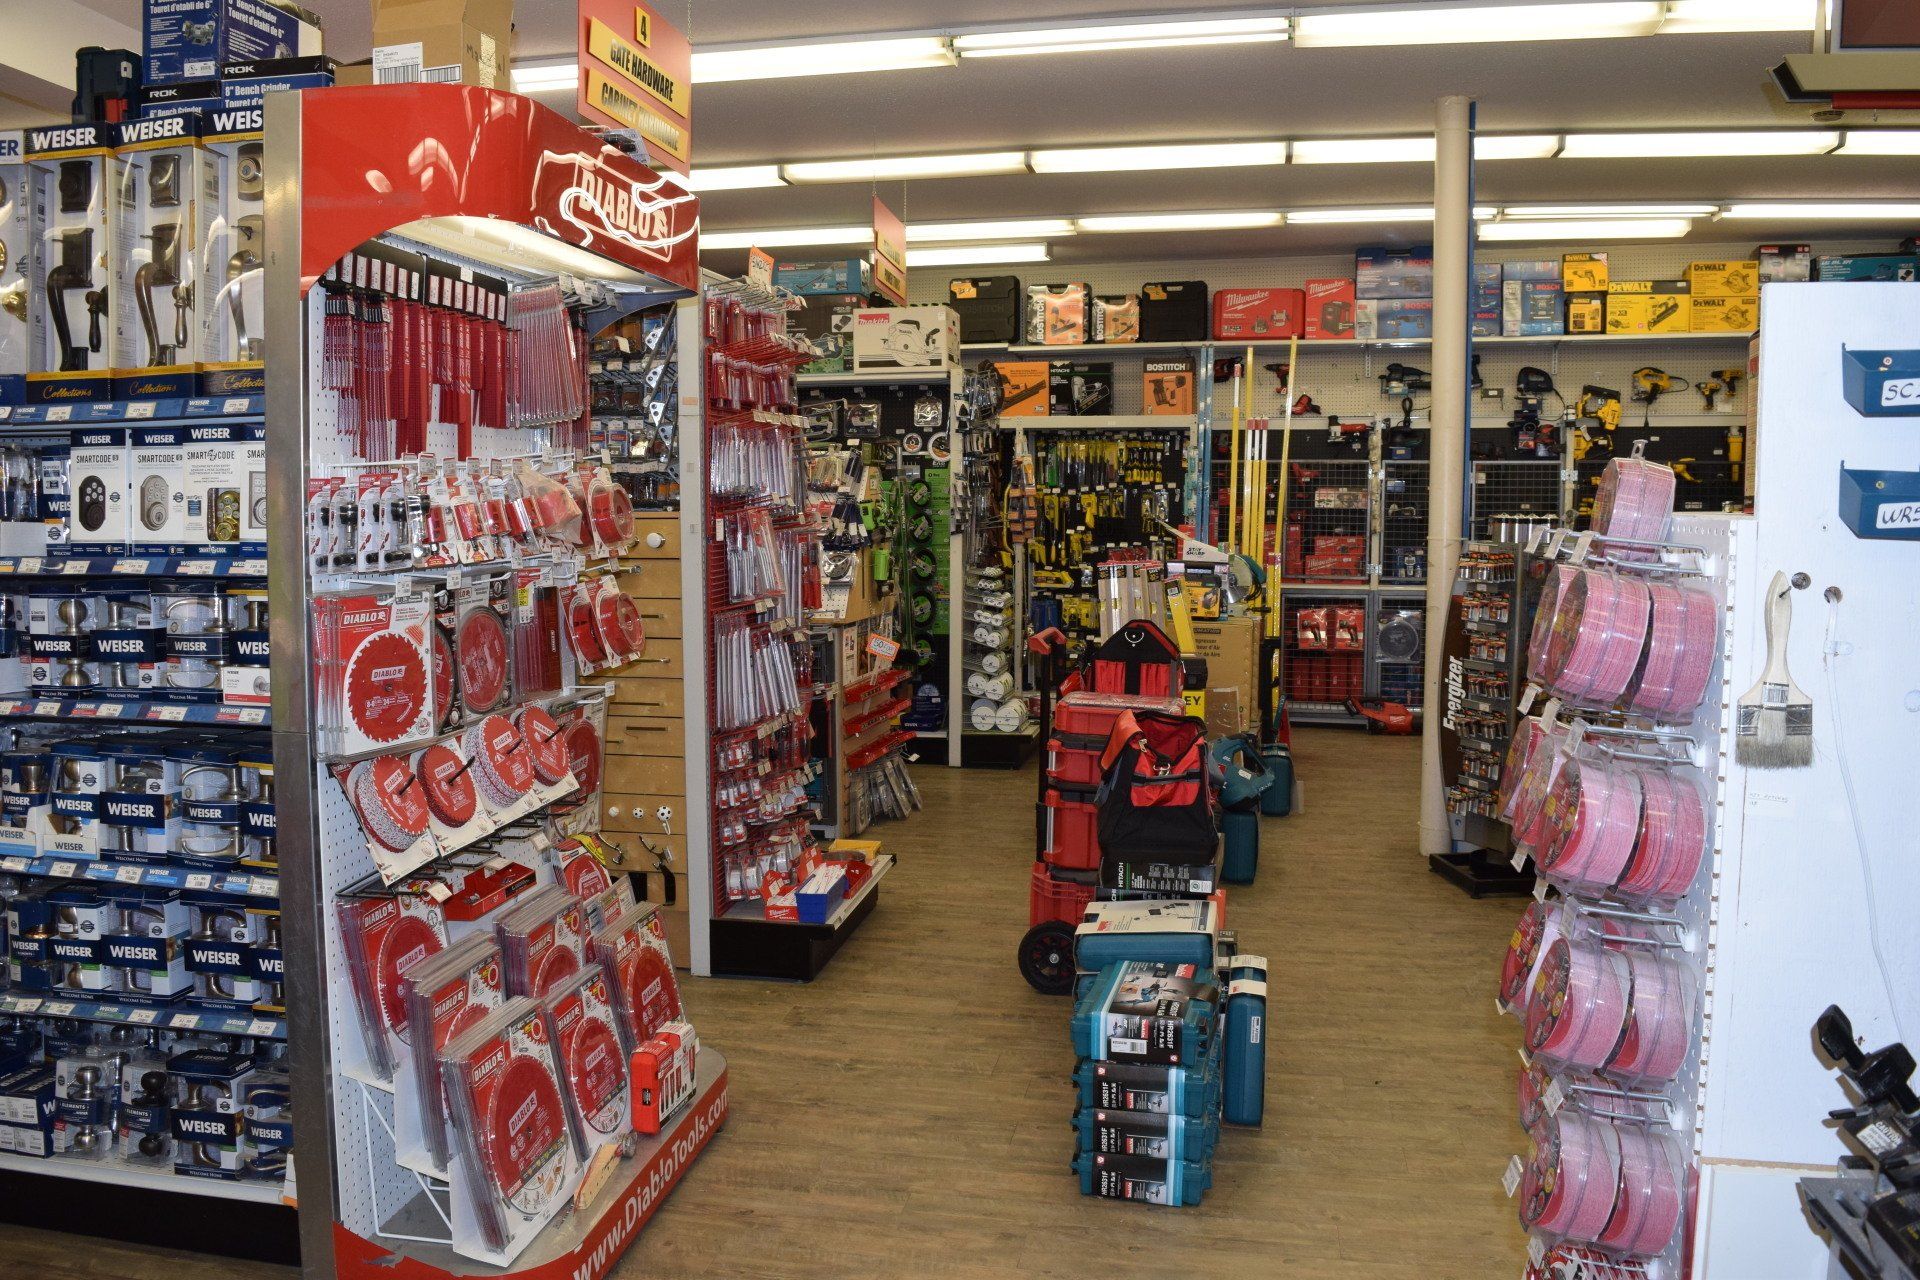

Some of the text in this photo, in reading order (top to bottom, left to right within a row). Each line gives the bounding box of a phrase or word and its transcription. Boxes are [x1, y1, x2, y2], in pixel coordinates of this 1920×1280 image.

[228, 7, 249, 24] Touret
[255, 7, 278, 24] Grinder
[640, 15, 647, 42] 4
[224, 65, 256, 74] ROK
[610, 38, 674, 102] GATE HARDWARE
[149, 89, 178, 98] ROK
[235, 84, 260, 96] Bench
[121, 117, 185, 142] WEISER
[32, 126, 98, 151] WEISER
[579, 168, 651, 238] DIABLO
[1309, 279, 1346, 294] Milwaukee
[1225, 290, 1270, 307] Milwaukee
[1036, 299, 1046, 340] BOSTITCH
[1146, 363, 1186, 371] BOSTITCH
[43, 384, 92, 398] Collections
[128, 380, 176, 395] Collections
[1884, 383, 1920, 401] SC
[82, 435, 112, 444] WEISER
[144, 434, 175, 444] WEISER
[190, 427, 230, 440] WEISER
[76, 454, 111, 464] SMARTCODE
[137, 454, 175, 464] SMARTCODE
[186, 450, 235, 460] SMART CODE
[343, 612, 377, 625] DIABLO
[34, 640, 72, 652] WEISER
[98, 639, 144, 652] WEISER
[174, 641, 206, 652] WEISER
[373, 670, 397, 679] DIABLO
[1443, 655, 1464, 731] Energizer
[1184, 695, 1201, 706] EY
[3, 794, 30, 806] WEISER
[55, 799, 94, 812] WEISER
[107, 802, 154, 818] WEISER
[189, 807, 222, 819] WEISER
[54, 841, 84, 851] WEISER
[184, 859, 202, 867] WELCOME
[149, 868, 170, 876] WEISER
[364, 907, 388, 928] DIABLO
[12, 940, 40, 951] WEISER
[54, 944, 92, 958] WEISER
[109, 945, 158, 960] WEISER
[192, 950, 241, 966] WEISER
[398, 952, 419, 971] DIABLO
[434, 994, 458, 1018] DIABLO
[226, 1018, 247, 1026] WEISER
[557, 1007, 578, 1030] DIABLO
[1166, 1020, 1174, 1050] HR2631F
[235, 1060, 251, 1072] WEISER
[473, 1055, 500, 1082] DIABLO
[61, 1102, 86, 1110] ELEMENTS
[126, 1108, 149, 1117] ELEMENTS
[509, 1099, 532, 1134] DIABLO
[179, 1117, 228, 1136] WEISER
[251, 1126, 283, 1140] WEISER
[572, 1089, 729, 1280] www.DiabloTools.com
